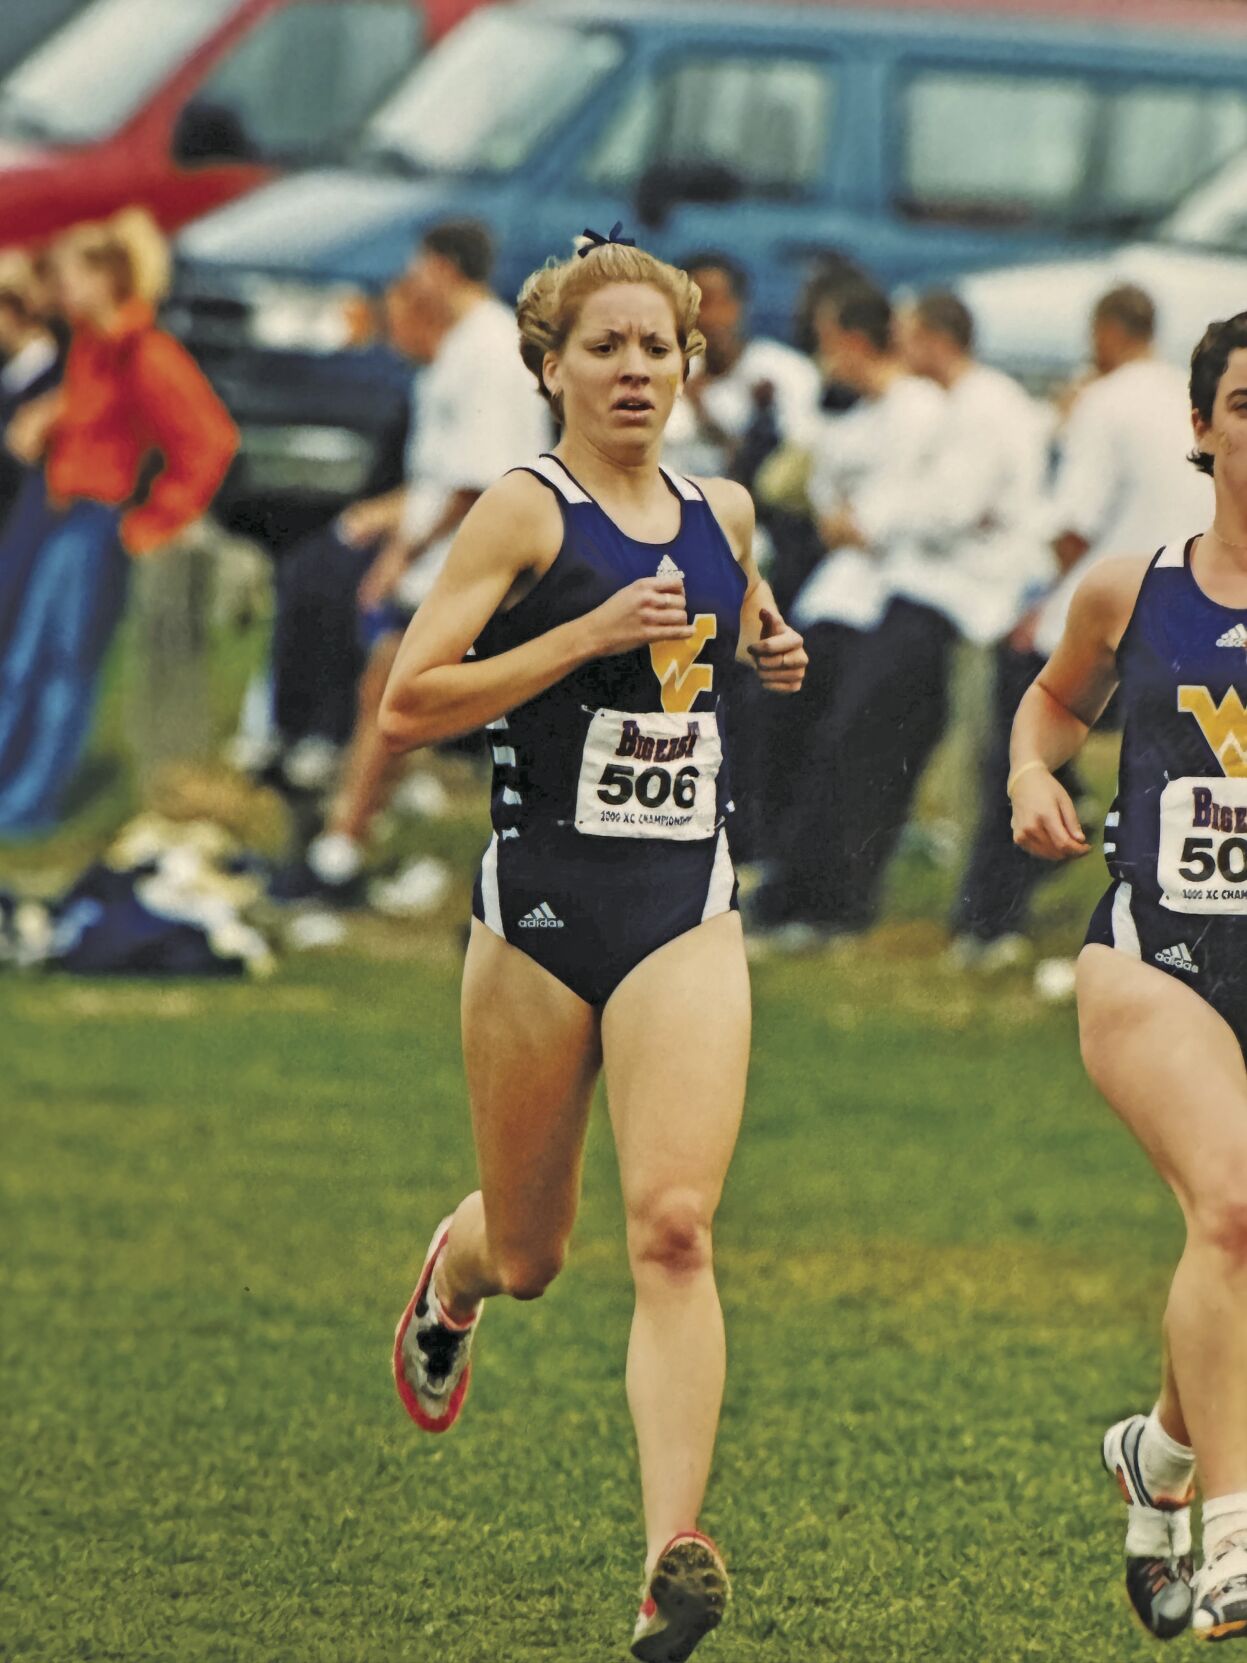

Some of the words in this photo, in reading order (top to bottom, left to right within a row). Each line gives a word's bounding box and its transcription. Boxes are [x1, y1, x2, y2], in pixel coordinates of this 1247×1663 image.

[596, 763, 700, 809] 506
[623, 811, 635, 824] XC
[1178, 837, 1247, 883] 50
[1206, 890, 1219, 900] XC
[518, 918, 565, 928] adidas
